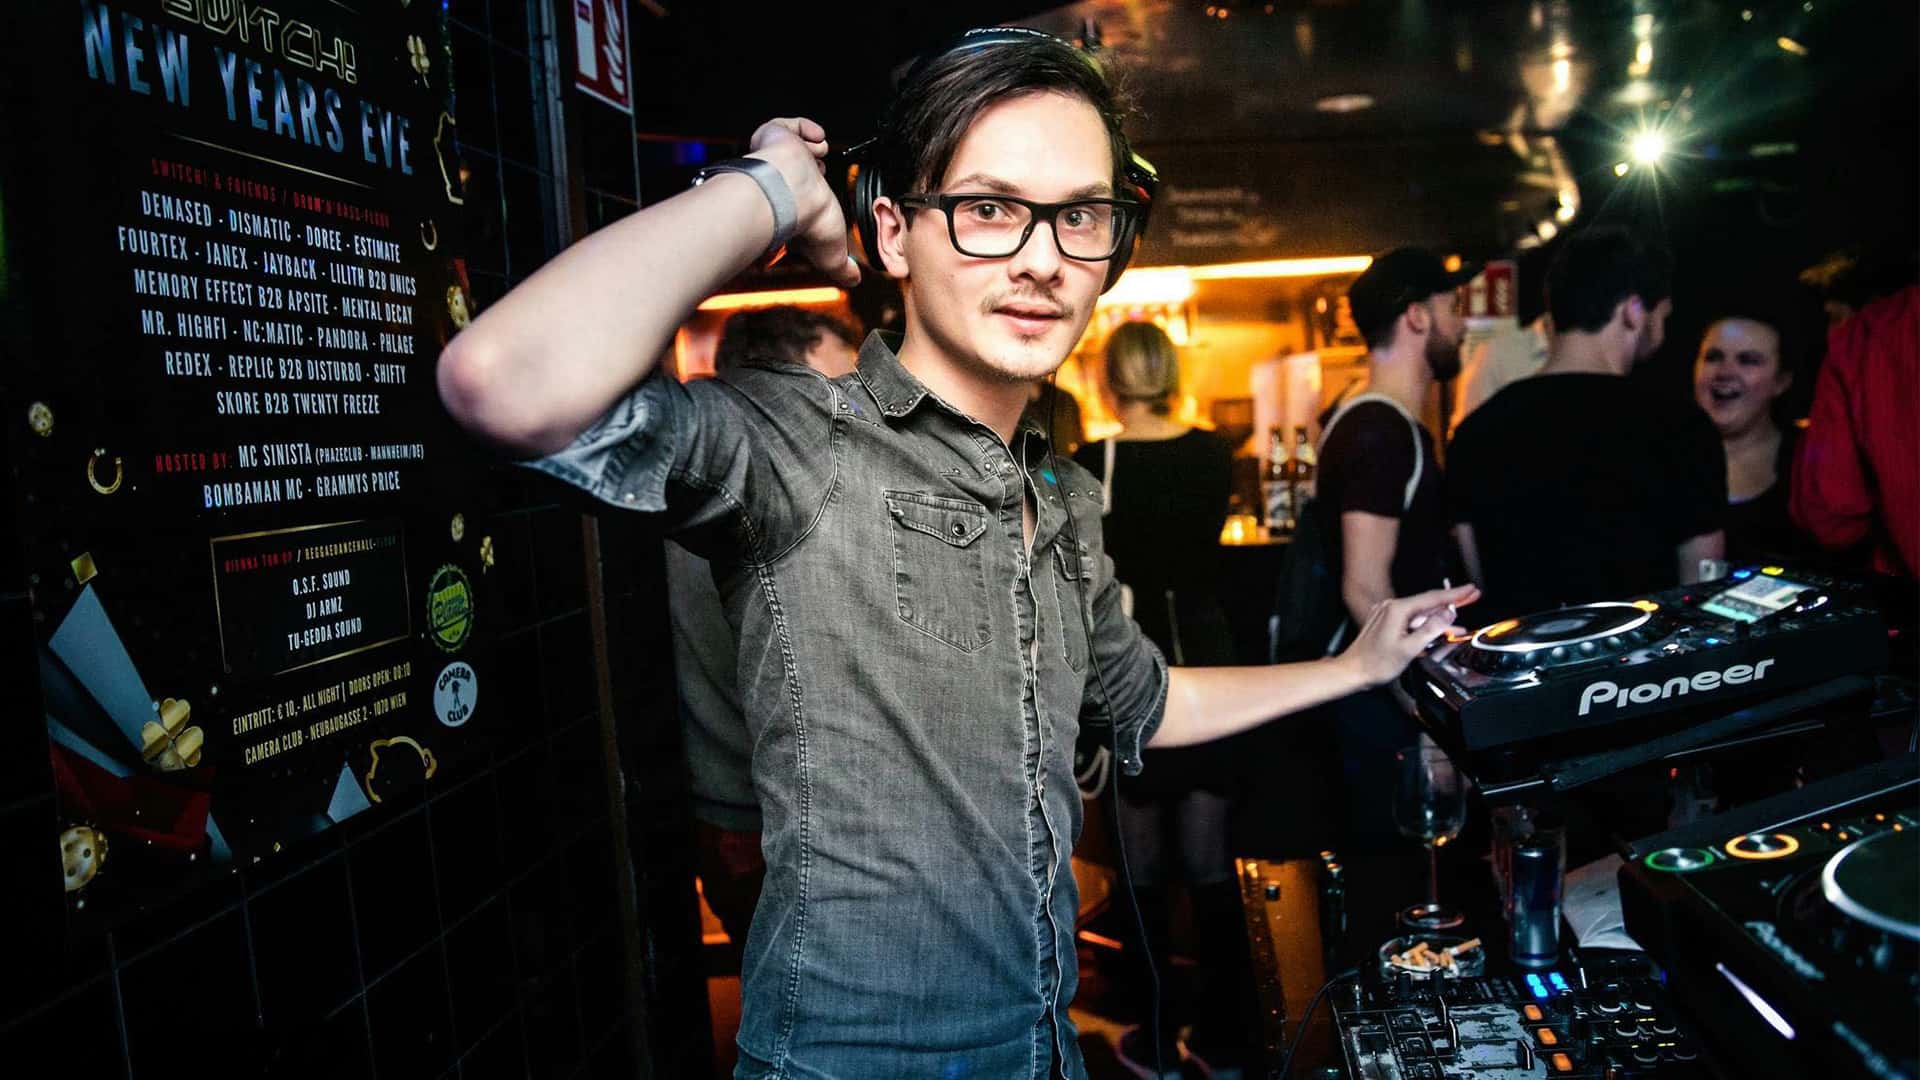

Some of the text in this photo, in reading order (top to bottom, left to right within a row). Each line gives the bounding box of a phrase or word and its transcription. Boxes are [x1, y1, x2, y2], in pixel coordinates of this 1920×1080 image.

[161, 0, 358, 85] SWITCH!
[81, 0, 414, 176] NEW YEARS EVE
[140, 189, 401, 264] DEMASED DISMATIC DOREE ESTIMATE
[117, 225, 417, 297] FOURTEX JANEX JAYBACK LILITH B2B UNICS
[133, 268, 414, 326] MEMORY EFFECT B2B APSITE MENTAL DECAY
[141, 308, 415, 356] MR. HIGHFI NC:MATIC PANDORA PHLAGE
[164, 350, 407, 385] REDEX REPLIC B2B DISTURBO SHIFTY
[216, 390, 381, 416] SKORE B2B TWENTY FREEZE
[154, 453, 206, 473] HOSTED
[237, 445, 258, 469] MC
[263, 443, 313, 468] SINISTA
[203, 470, 401, 509] BOMBAMAN MC GRAMMYS PRICE
[292, 568, 351, 597] O.S.F. SOUND
[306, 595, 344, 620] DJ ARMZ
[288, 616, 363, 652] TU-GEDDA SOUND
[438, 666, 471, 692] CAMERA
[1577, 657, 1776, 717] Pioneer
[233, 707, 277, 736] EINTRITT:
[302, 693, 316, 713] ALL
[317, 683, 341, 709] NIGHT
[348, 675, 372, 696] DOORS
[447, 703, 470, 723] CLUB
[244, 735, 281, 767] CAMERA
[282, 728, 304, 752] CLUB
[309, 708, 361, 742] NEUBAUGASSE
[361, 704, 369, 721] 2
[390, 691, 407, 710] WIEN
